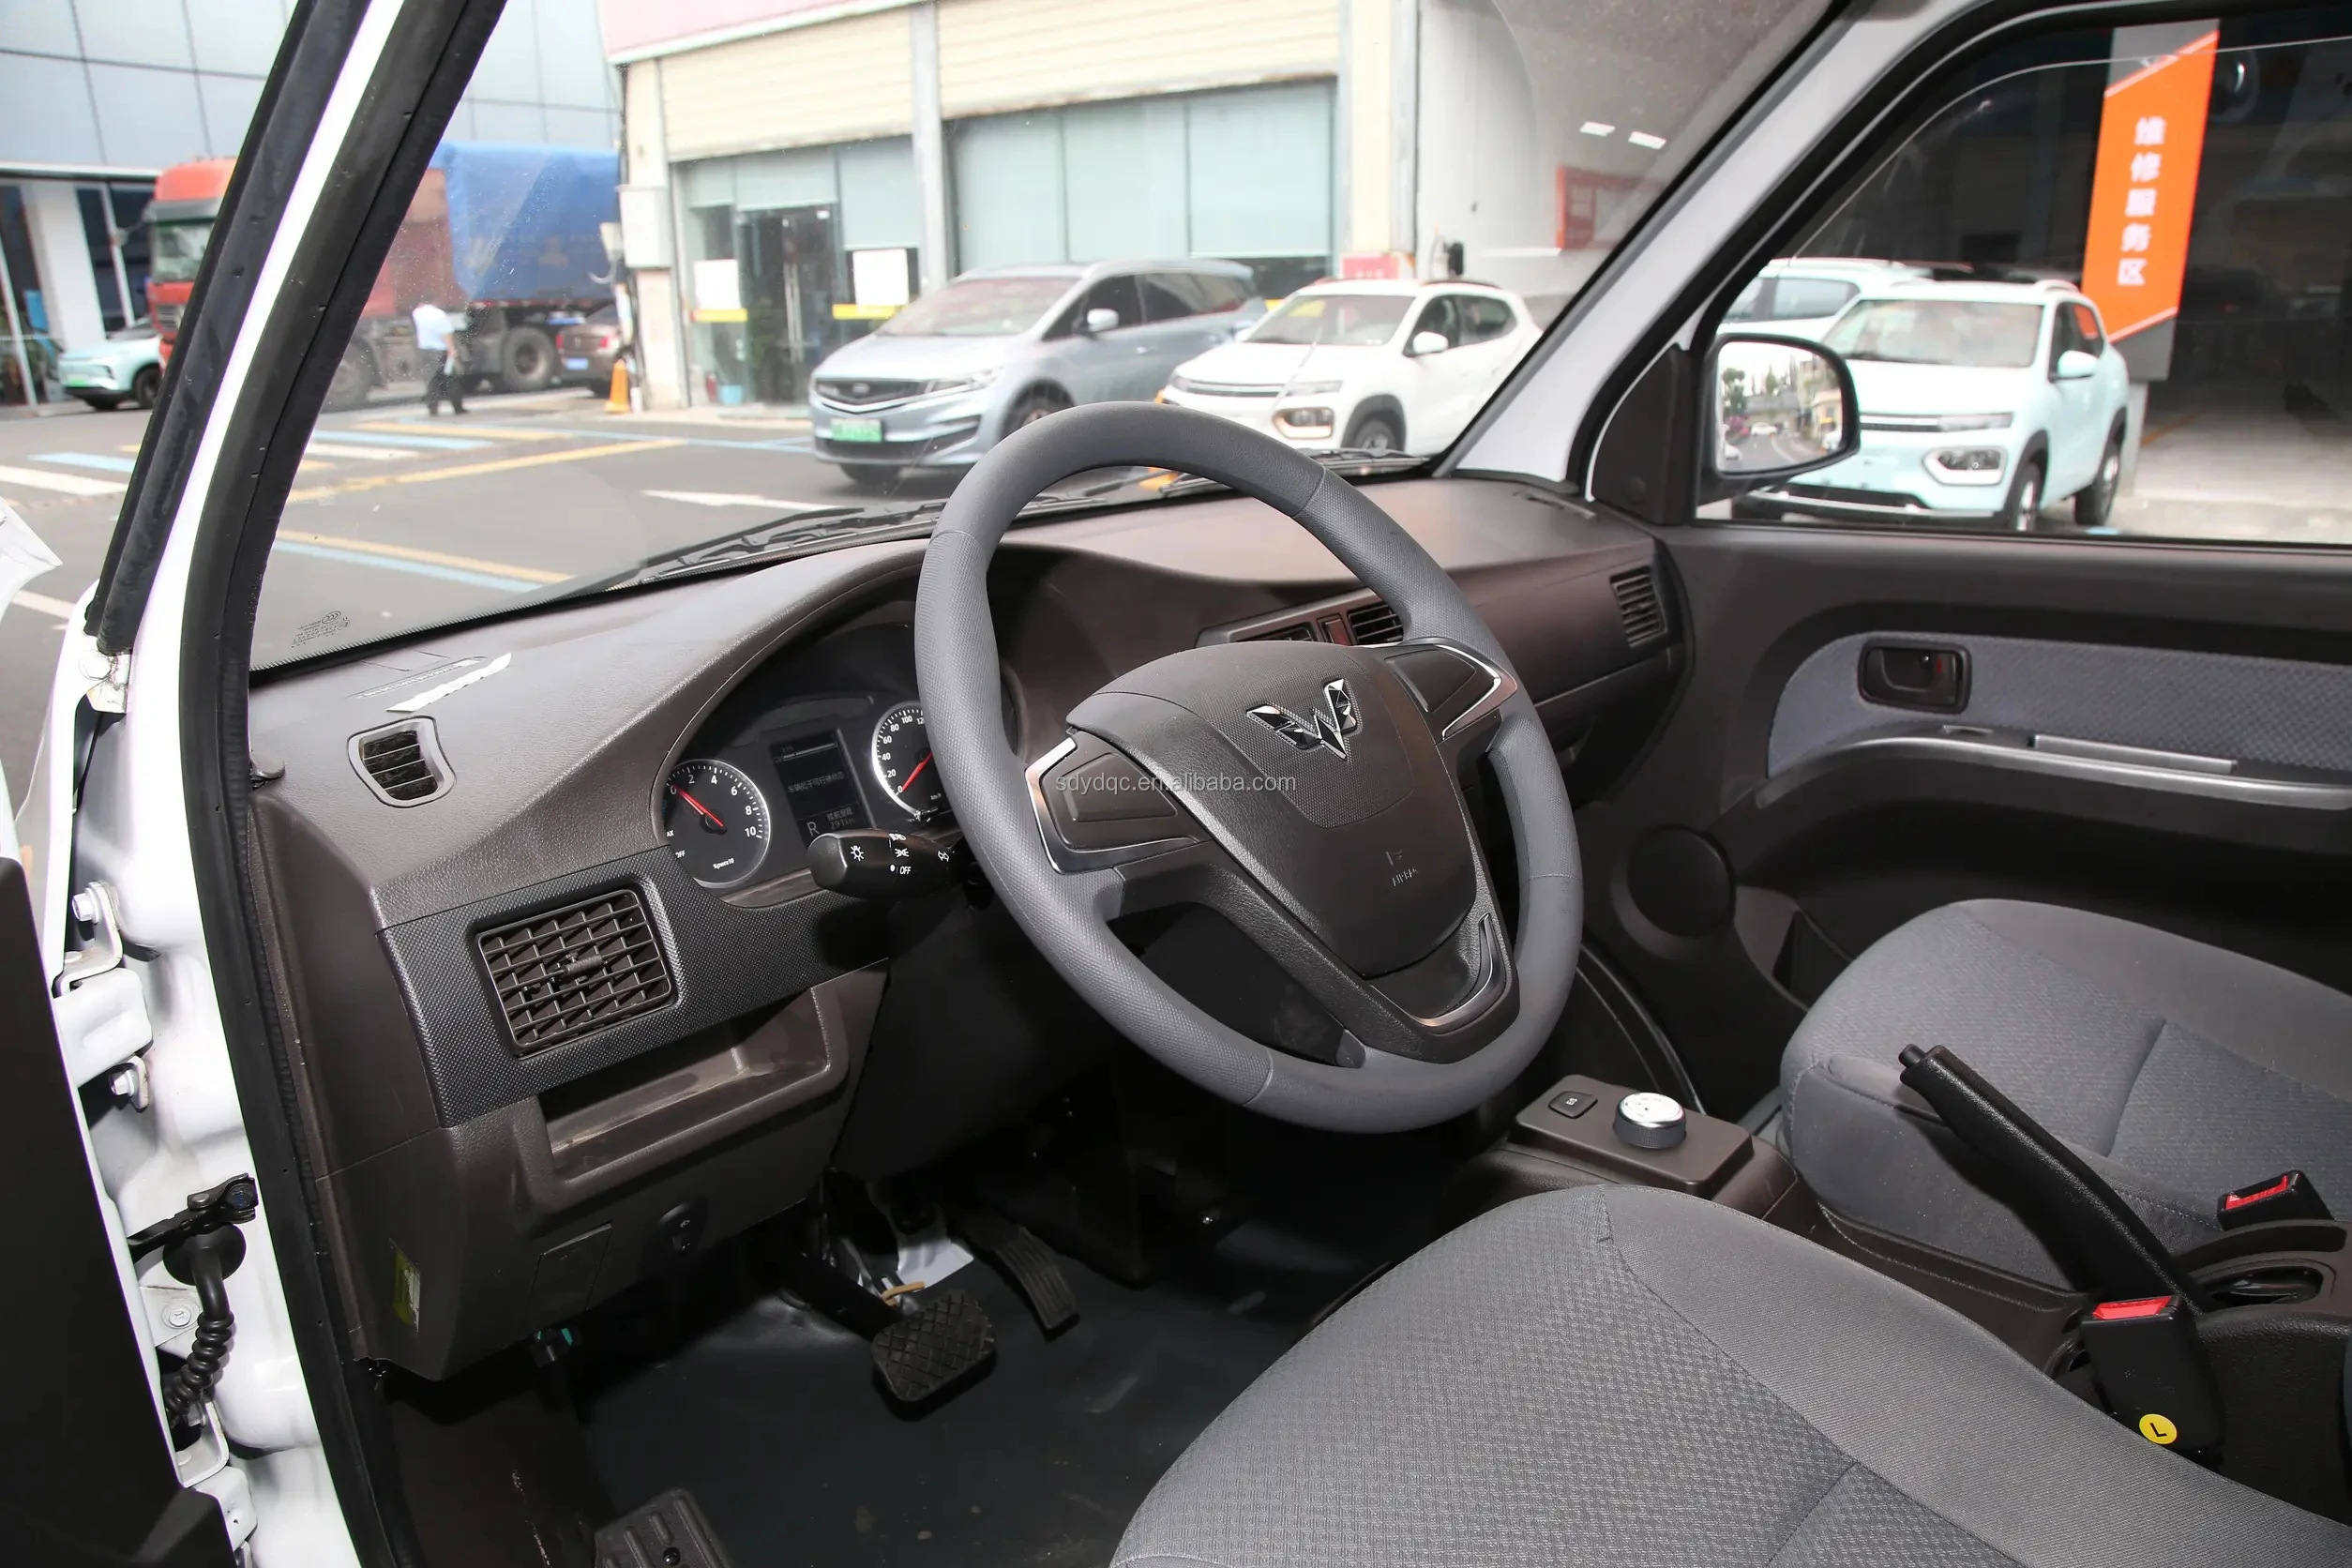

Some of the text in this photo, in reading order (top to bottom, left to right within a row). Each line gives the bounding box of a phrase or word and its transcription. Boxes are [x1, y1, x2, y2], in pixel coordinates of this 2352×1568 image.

[2117, 115, 2167, 286] 维修服务区
[902, 716, 912, 724] 100
[882, 752, 892, 761] 40
[887, 769, 897, 778] 20
[688, 775, 695, 784] 2
[711, 775, 717, 784] 4
[670, 785, 677, 794] 0
[731, 786, 738, 795] 6
[746, 806, 752, 815] 8
[745, 826, 756, 837] 10
[807, 822, 820, 837] R
[899, 866, 912, 875] OFF
[2149, 1422, 2167, 1438] L
